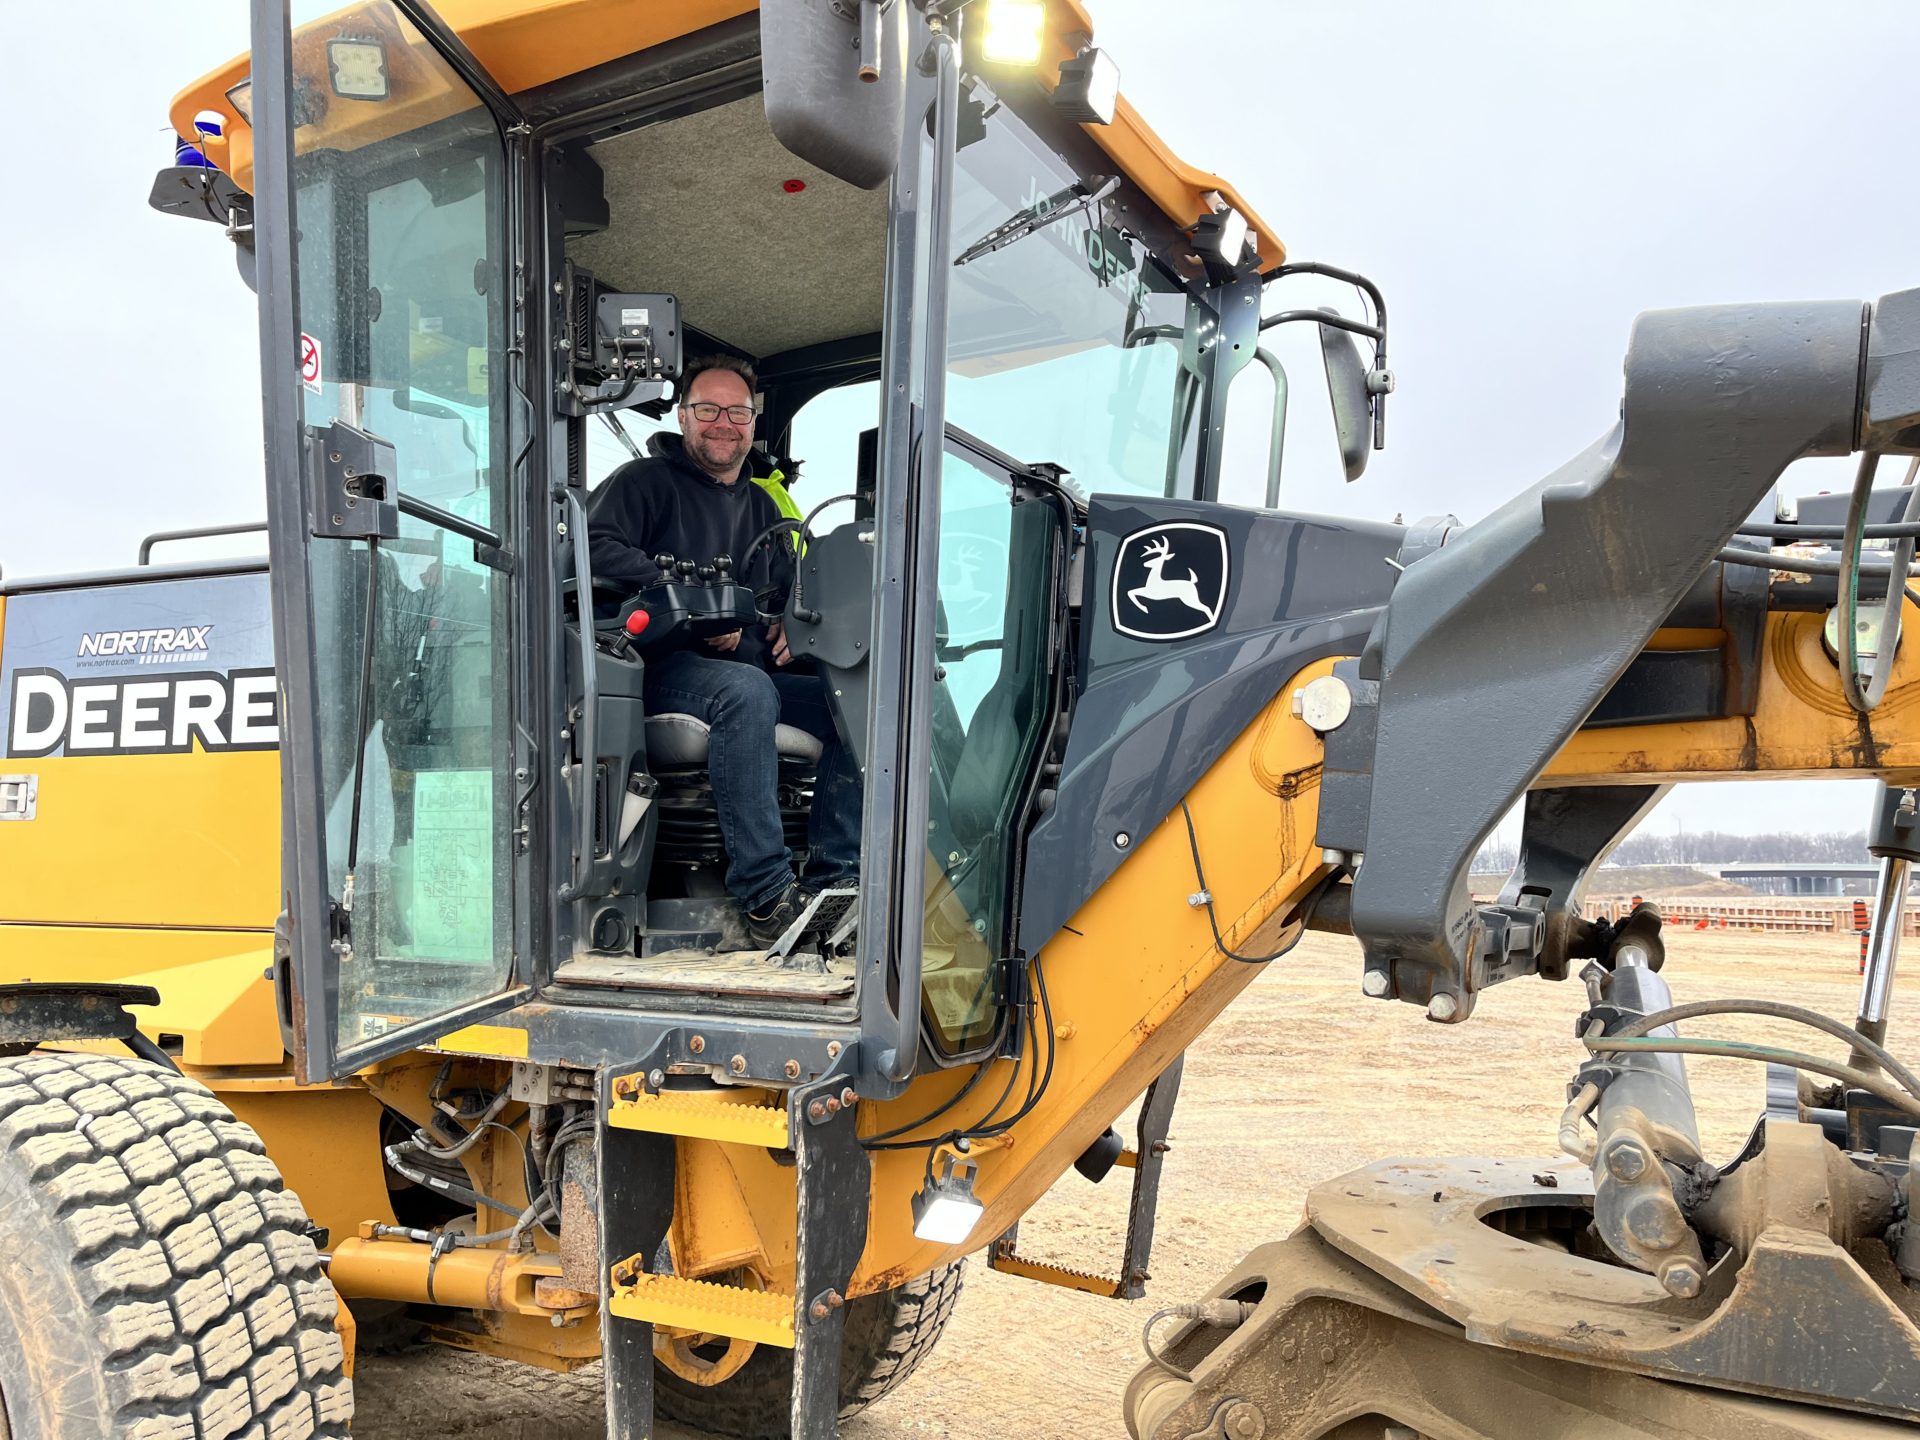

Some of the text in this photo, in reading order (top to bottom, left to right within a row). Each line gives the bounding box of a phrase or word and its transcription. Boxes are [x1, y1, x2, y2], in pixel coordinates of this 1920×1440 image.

[77, 625, 214, 657] NORTRAX
[76, 659, 135, 668] www.nortrax.com
[12, 674, 280, 751] DEERE
